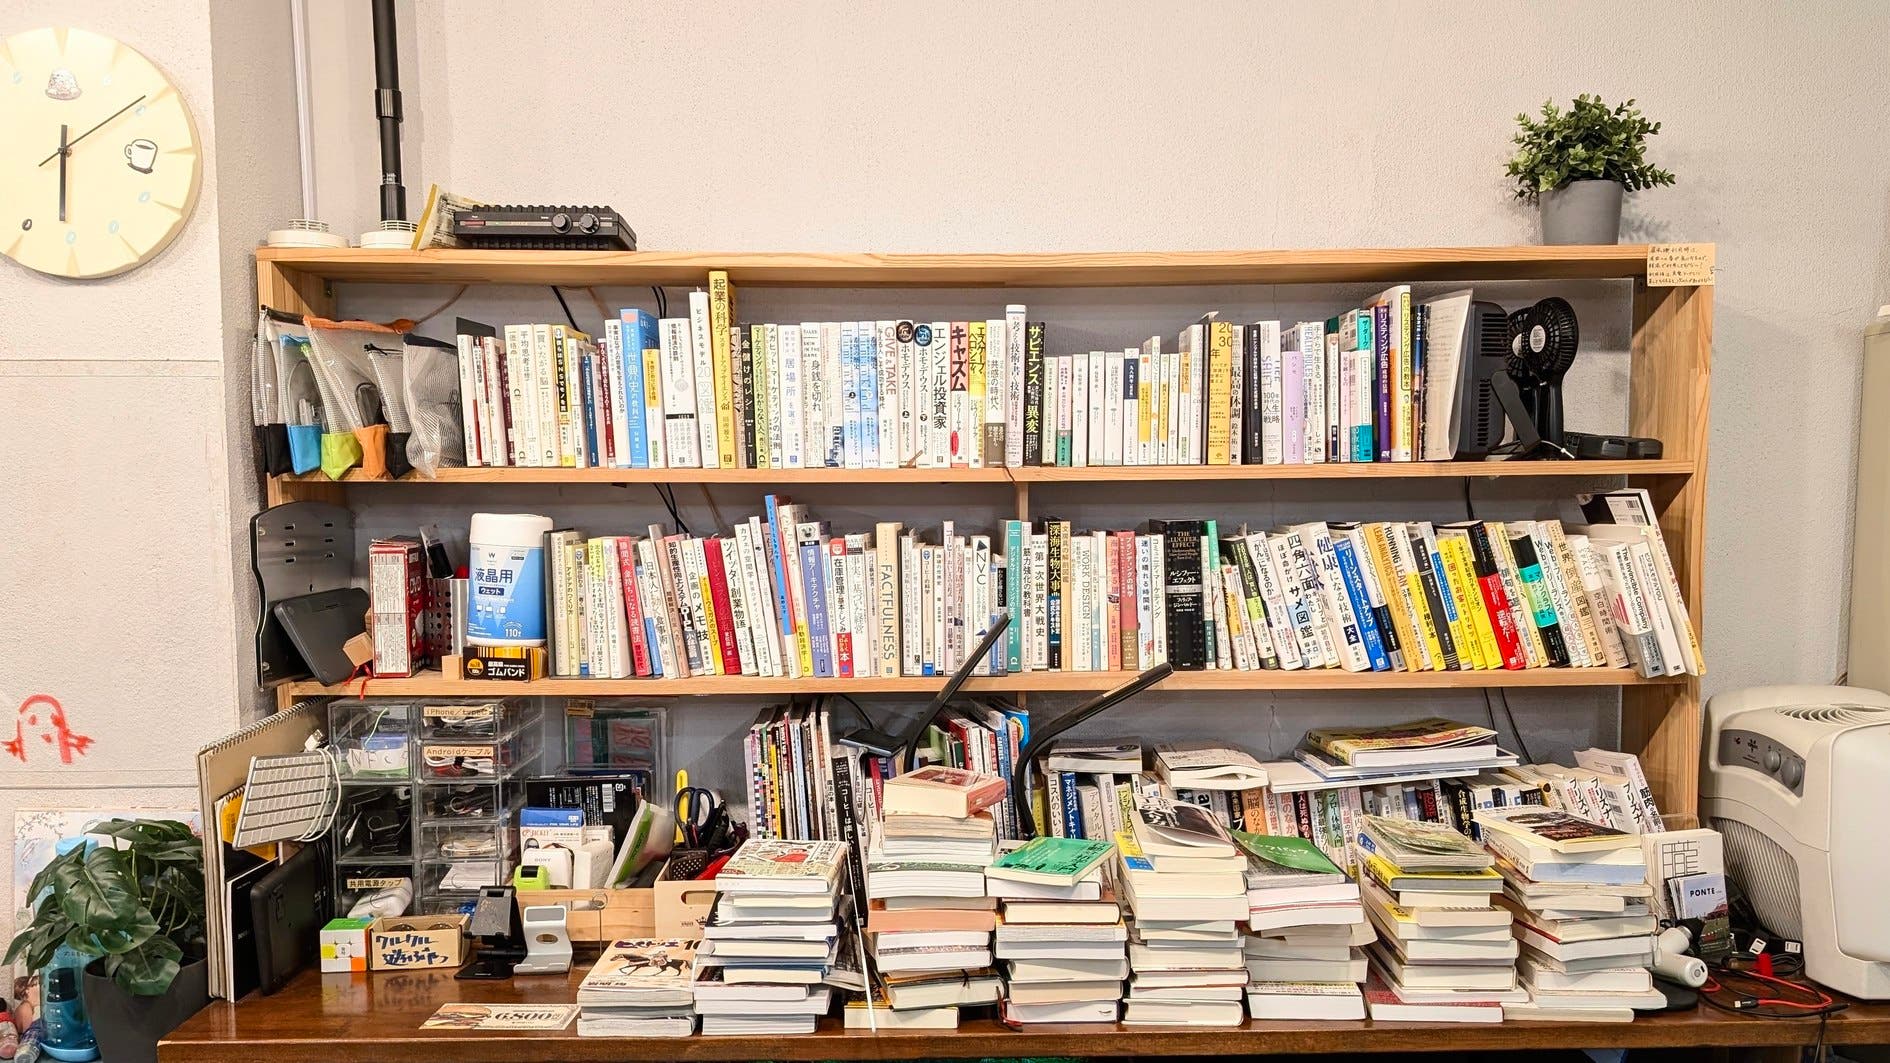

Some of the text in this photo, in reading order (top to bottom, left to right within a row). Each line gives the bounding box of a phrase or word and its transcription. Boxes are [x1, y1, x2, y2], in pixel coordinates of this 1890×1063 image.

[713, 279, 729, 336] 起業の科学
[885, 326, 895, 358] GIVE
[951, 325, 967, 392] キャズム
[1210, 348, 1221, 359] 年
[1380, 312, 1389, 369] リスティング広告
[811, 360, 822, 412] 身銭を切れ
[886, 366, 897, 396] TAKE
[933, 327, 947, 429] エンジェル投資家
[1026, 326, 1041, 433] サピエンス 異変
[1263, 404, 1280, 412] 人生
[1263, 416, 1281, 424] 戦略
[976, 552, 987, 586] NVC
[1126, 537, 1134, 598] ブランディングの科学
[1287, 534, 1316, 592] 四角六面
[1384, 526, 1401, 564] RUNNING
[475, 568, 513, 584] 液晶用
[668, 542, 688, 608] 知的生産性向上システム
[723, 541, 747, 629] ツイッター創業物語
[807, 549, 821, 611] 情報アーキテクチャ
[1023, 547, 1032, 618] 筋力強化の教科書
[1034, 551, 1046, 637] 第一次世界大戦史
[1081, 549, 1091, 621] WORK DESIGN
[1141, 540, 1151, 612] 迷いの晴れる時間術
[1152, 538, 1162, 619] コミュニティマーケティング
[1316, 536, 1360, 646] 健康になる技術大全
[1621, 547, 1649, 630] The Invincible Company
[1644, 552, 1664, 602] ビジネスモデルYOU
[688, 571, 709, 641] 企画のメモ技
[881, 564, 895, 660] FACTFULNESS
[488, 668, 525, 677] ゴムバンド
[1064, 779, 1076, 839] マネジメントキャリ
[349, 879, 402, 888] 共用電源タップ
[1689, 888, 1715, 897] PONTE
[375, 934, 439, 949] クルクル
